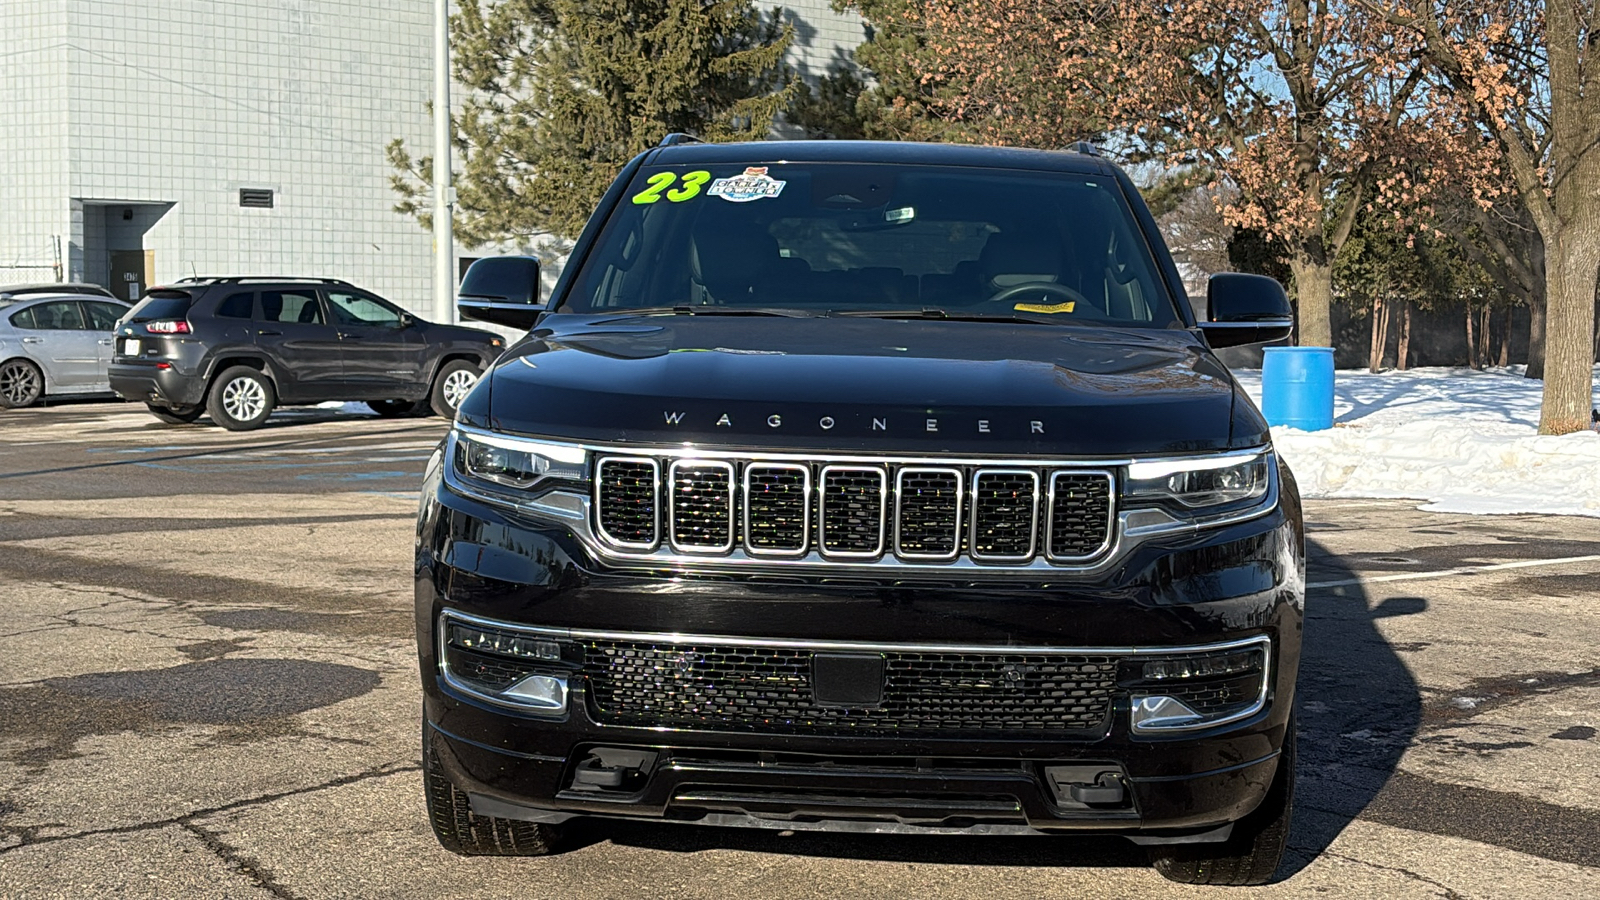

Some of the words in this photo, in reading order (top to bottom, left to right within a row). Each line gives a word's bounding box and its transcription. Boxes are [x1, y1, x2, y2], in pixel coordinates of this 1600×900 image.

[632, 171, 711, 204] 23
[716, 180, 778, 189] CARFAX
[664, 410, 1044, 434] WAGONEER
